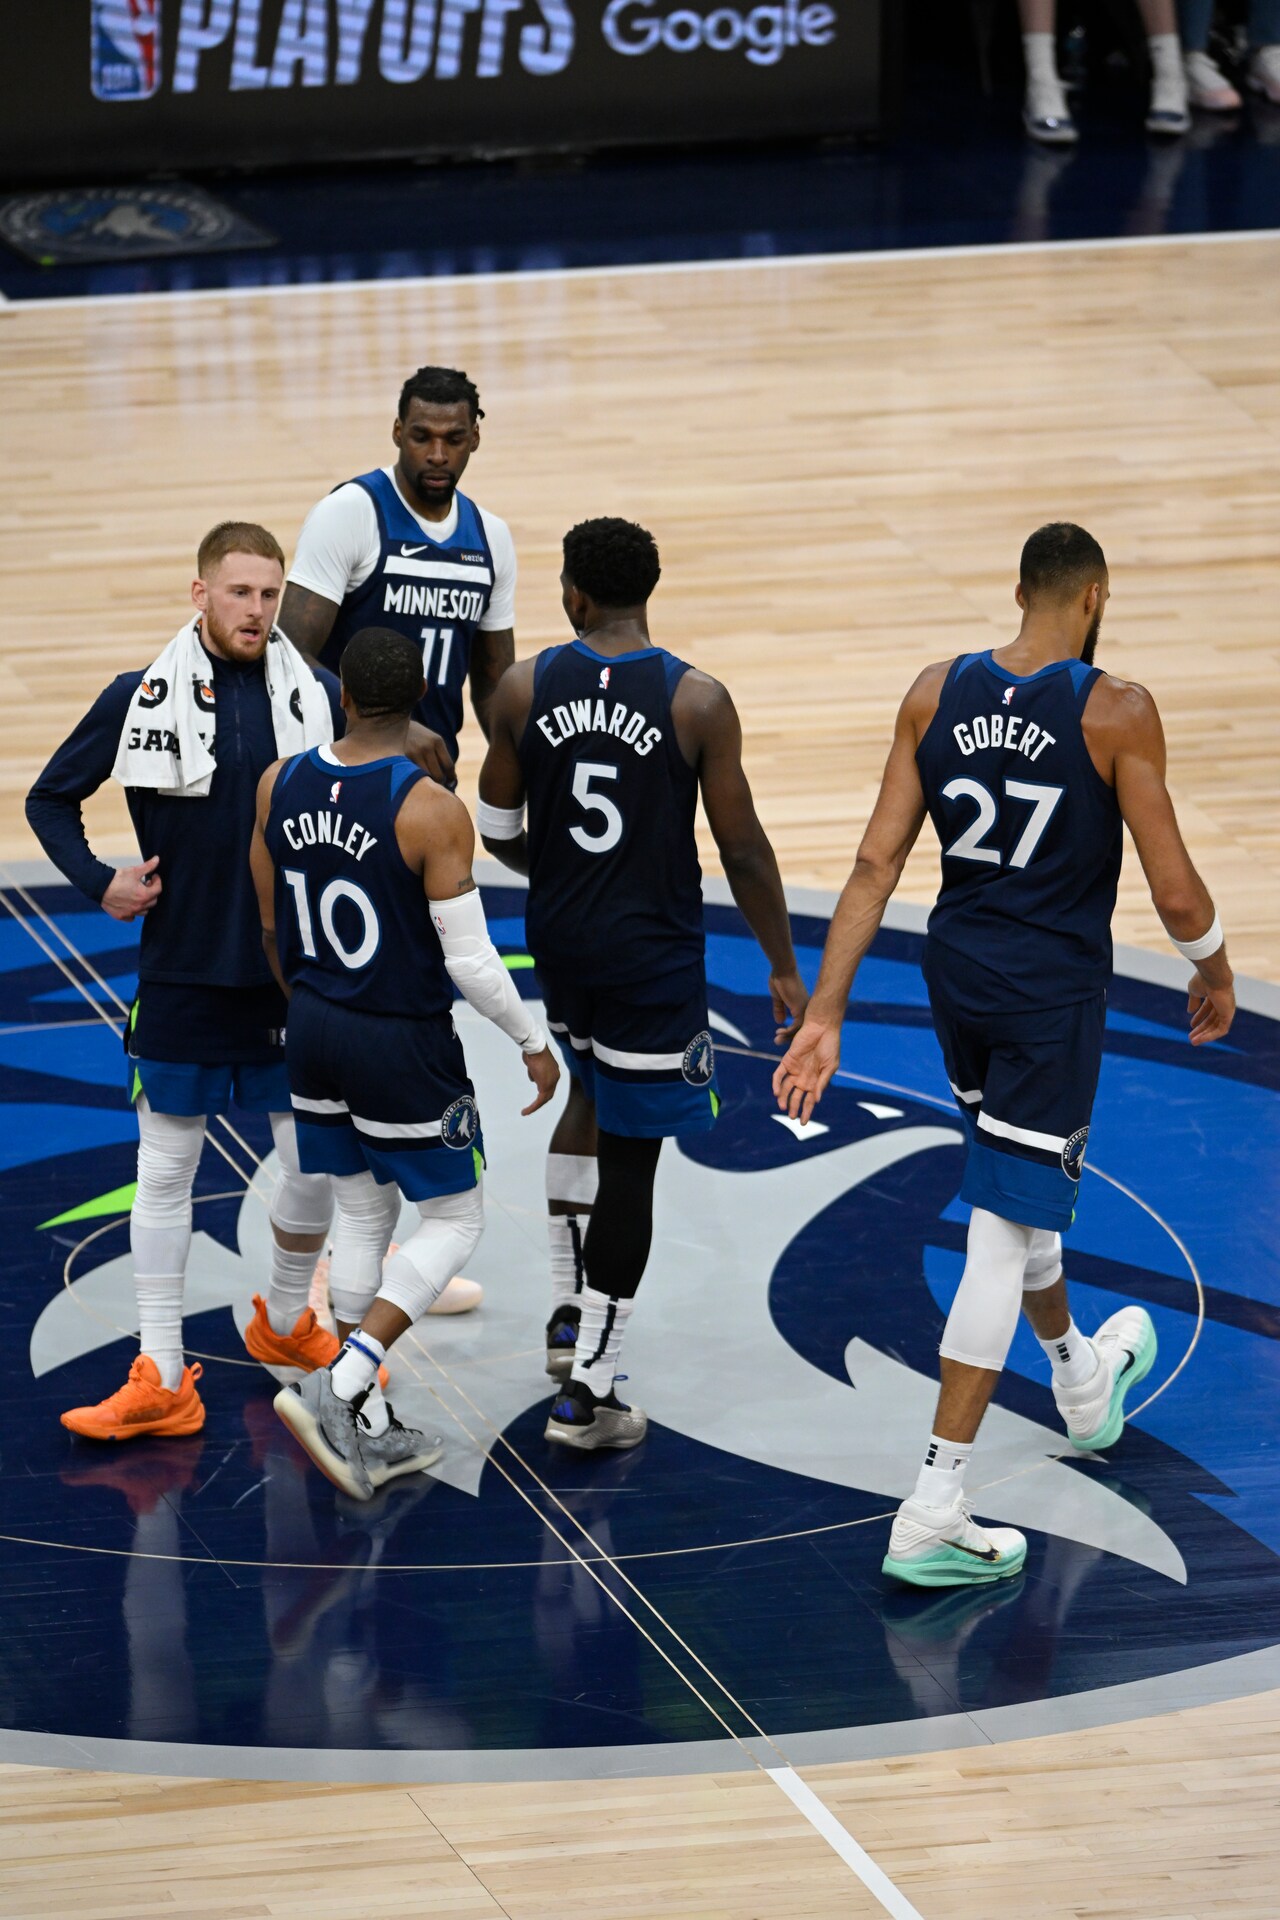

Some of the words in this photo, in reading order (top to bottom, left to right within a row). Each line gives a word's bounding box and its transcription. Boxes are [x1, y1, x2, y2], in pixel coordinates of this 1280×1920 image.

[173, 0, 575, 92] PLAYOFFS
[601, 0, 836, 65] Google
[383, 583, 484, 623] MINNESOTA
[420, 627, 454, 686] 11
[536, 699, 662, 756] EDWARDS
[953, 714, 1056, 762] GOBERT
[282, 810, 378, 862] CONLEY
[568, 762, 623, 853] 5
[941, 777, 1064, 869] 27
[283, 868, 380, 970] 10
